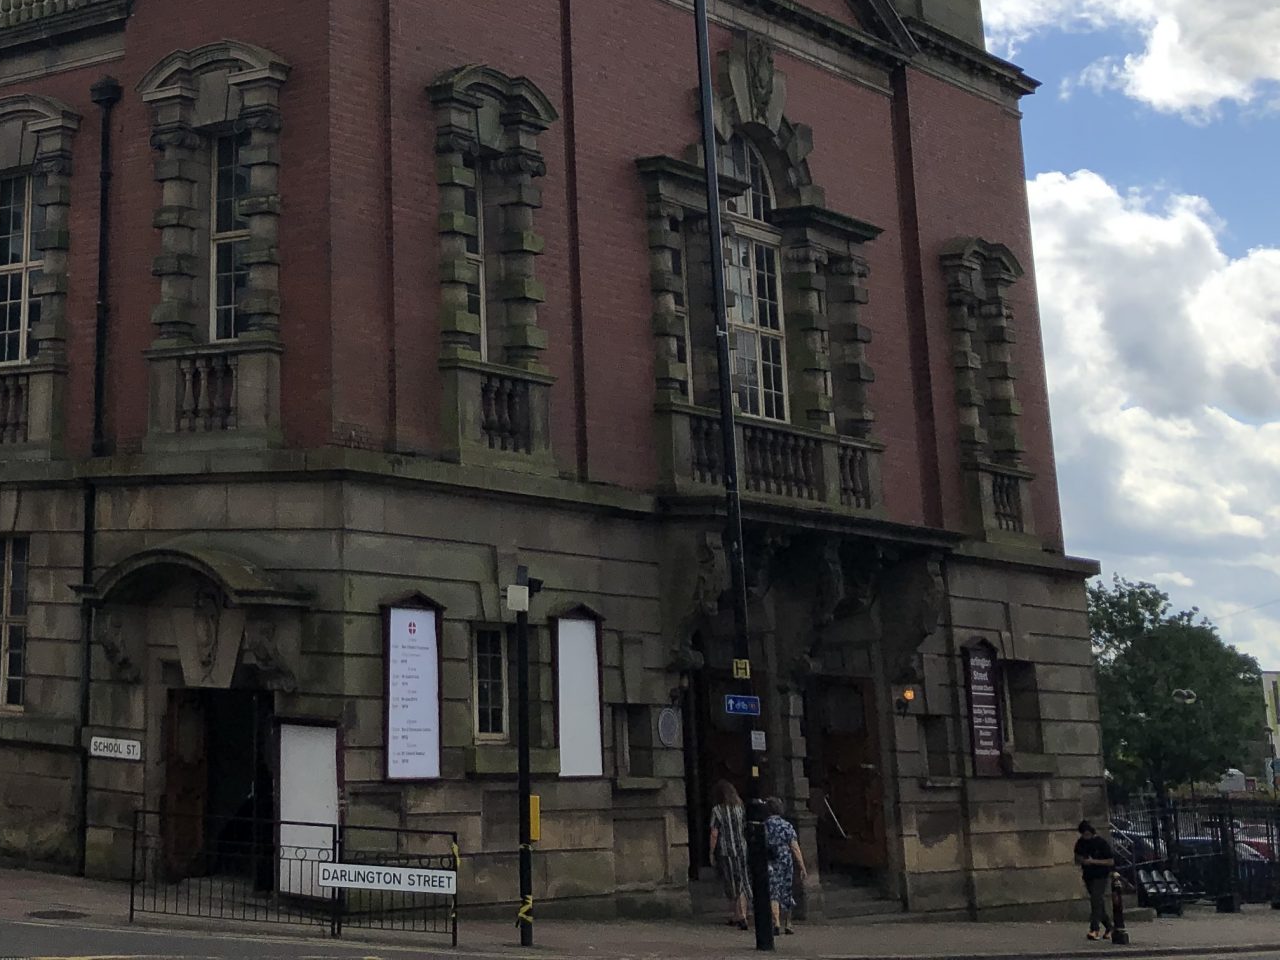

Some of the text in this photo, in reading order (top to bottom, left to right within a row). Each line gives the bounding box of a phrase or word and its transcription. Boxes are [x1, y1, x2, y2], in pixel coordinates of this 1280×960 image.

[93, 740, 123, 754] SCHOOL
[322, 868, 453, 889] DARLINGTON STREET
